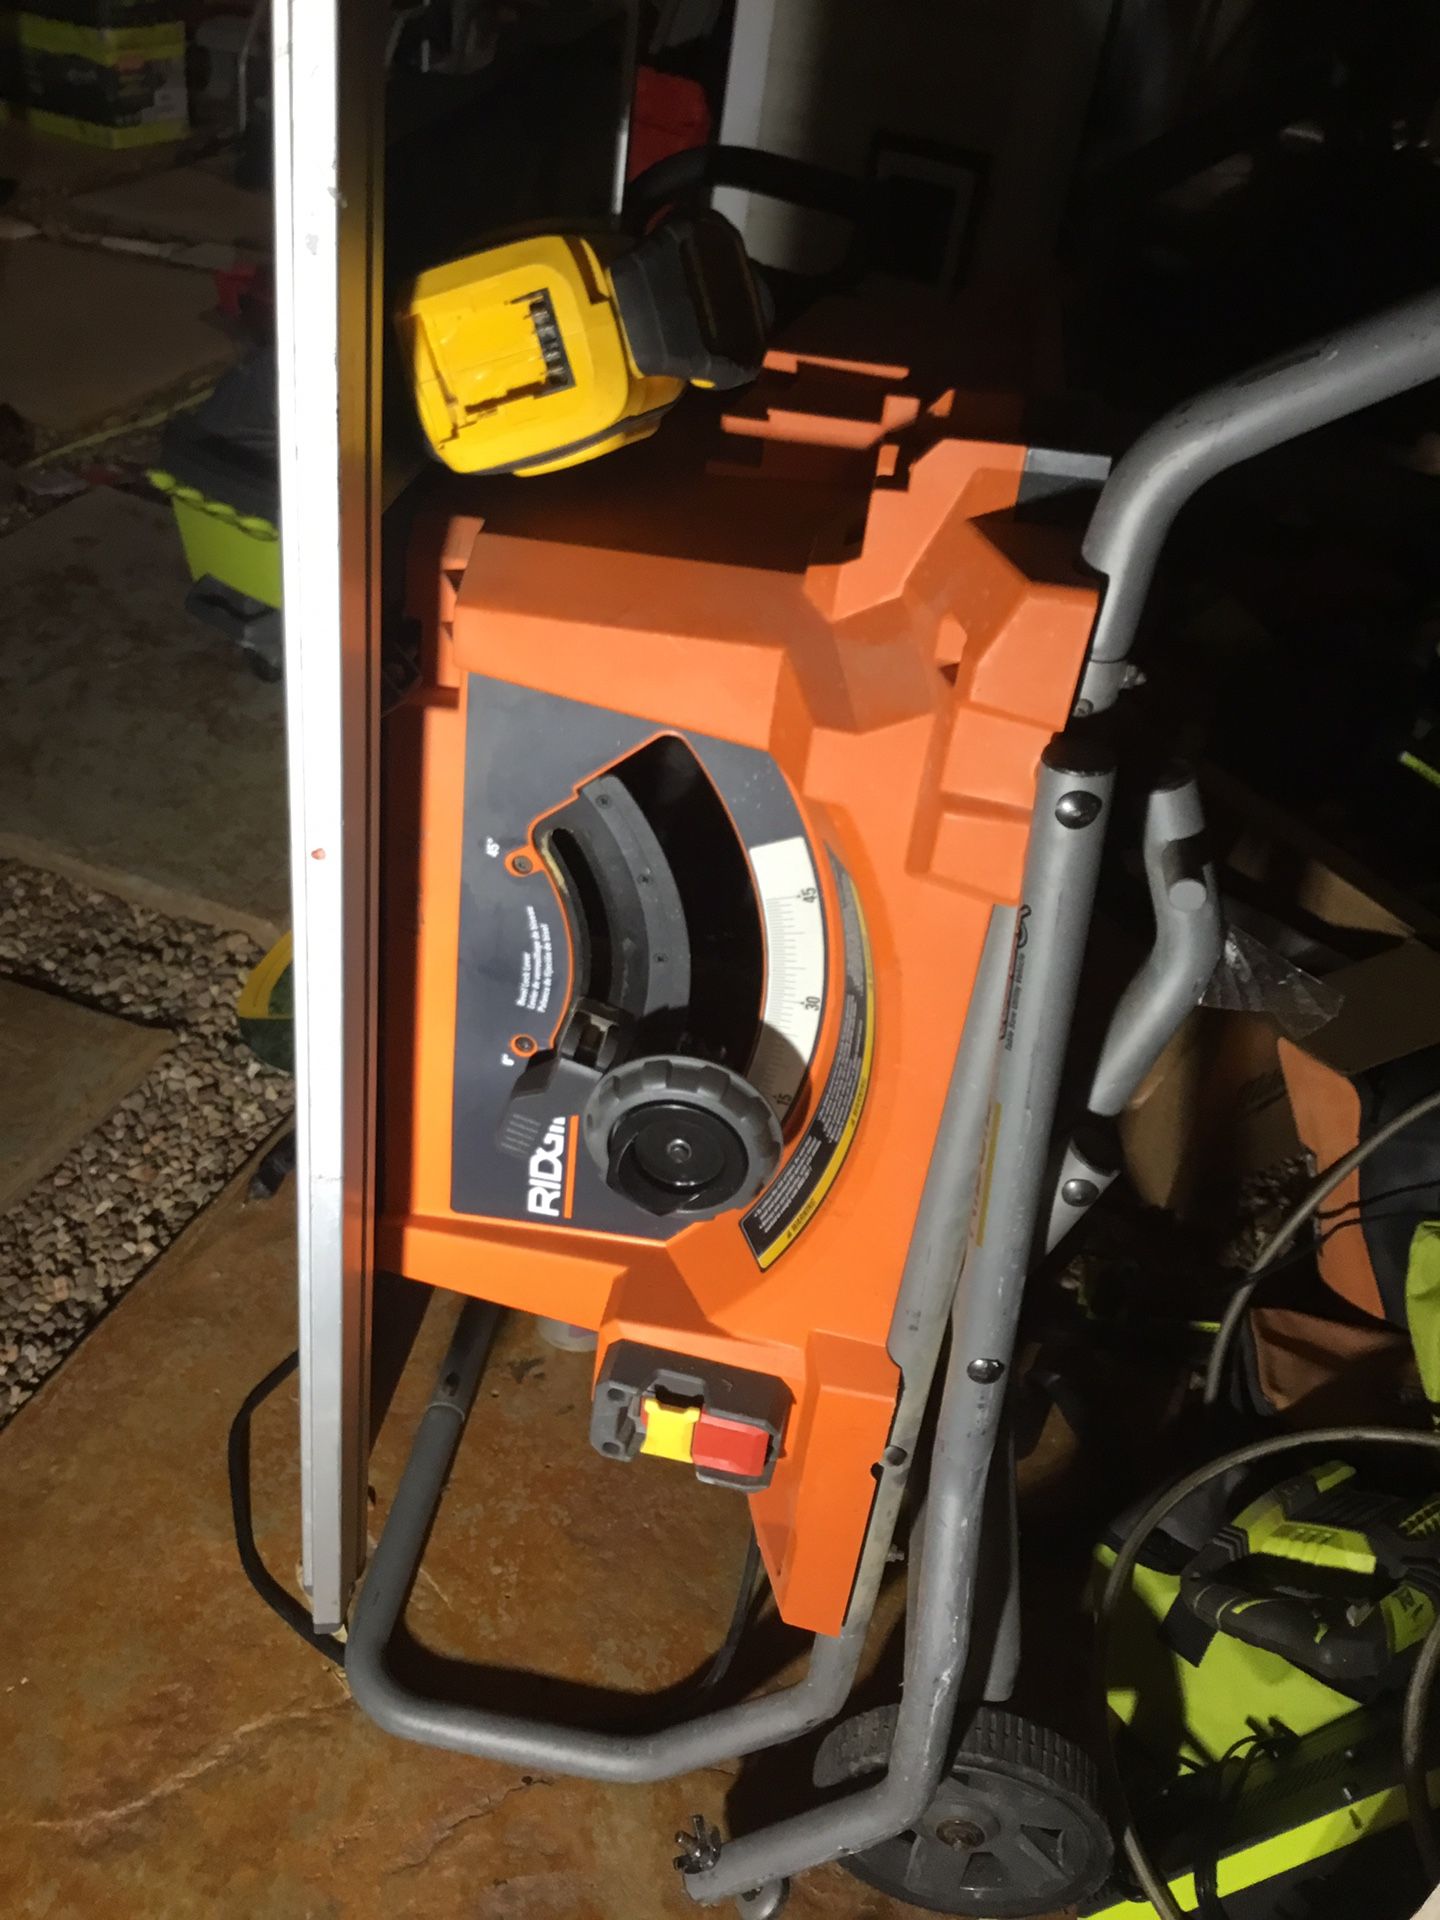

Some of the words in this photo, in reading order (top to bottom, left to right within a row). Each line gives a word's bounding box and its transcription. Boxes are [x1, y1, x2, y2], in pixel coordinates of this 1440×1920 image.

[801, 887, 818, 903] 45
[805, 996, 821, 1011] 30
[776, 1093, 792, 1106] 15
[527, 1116, 566, 1217] RIDG
